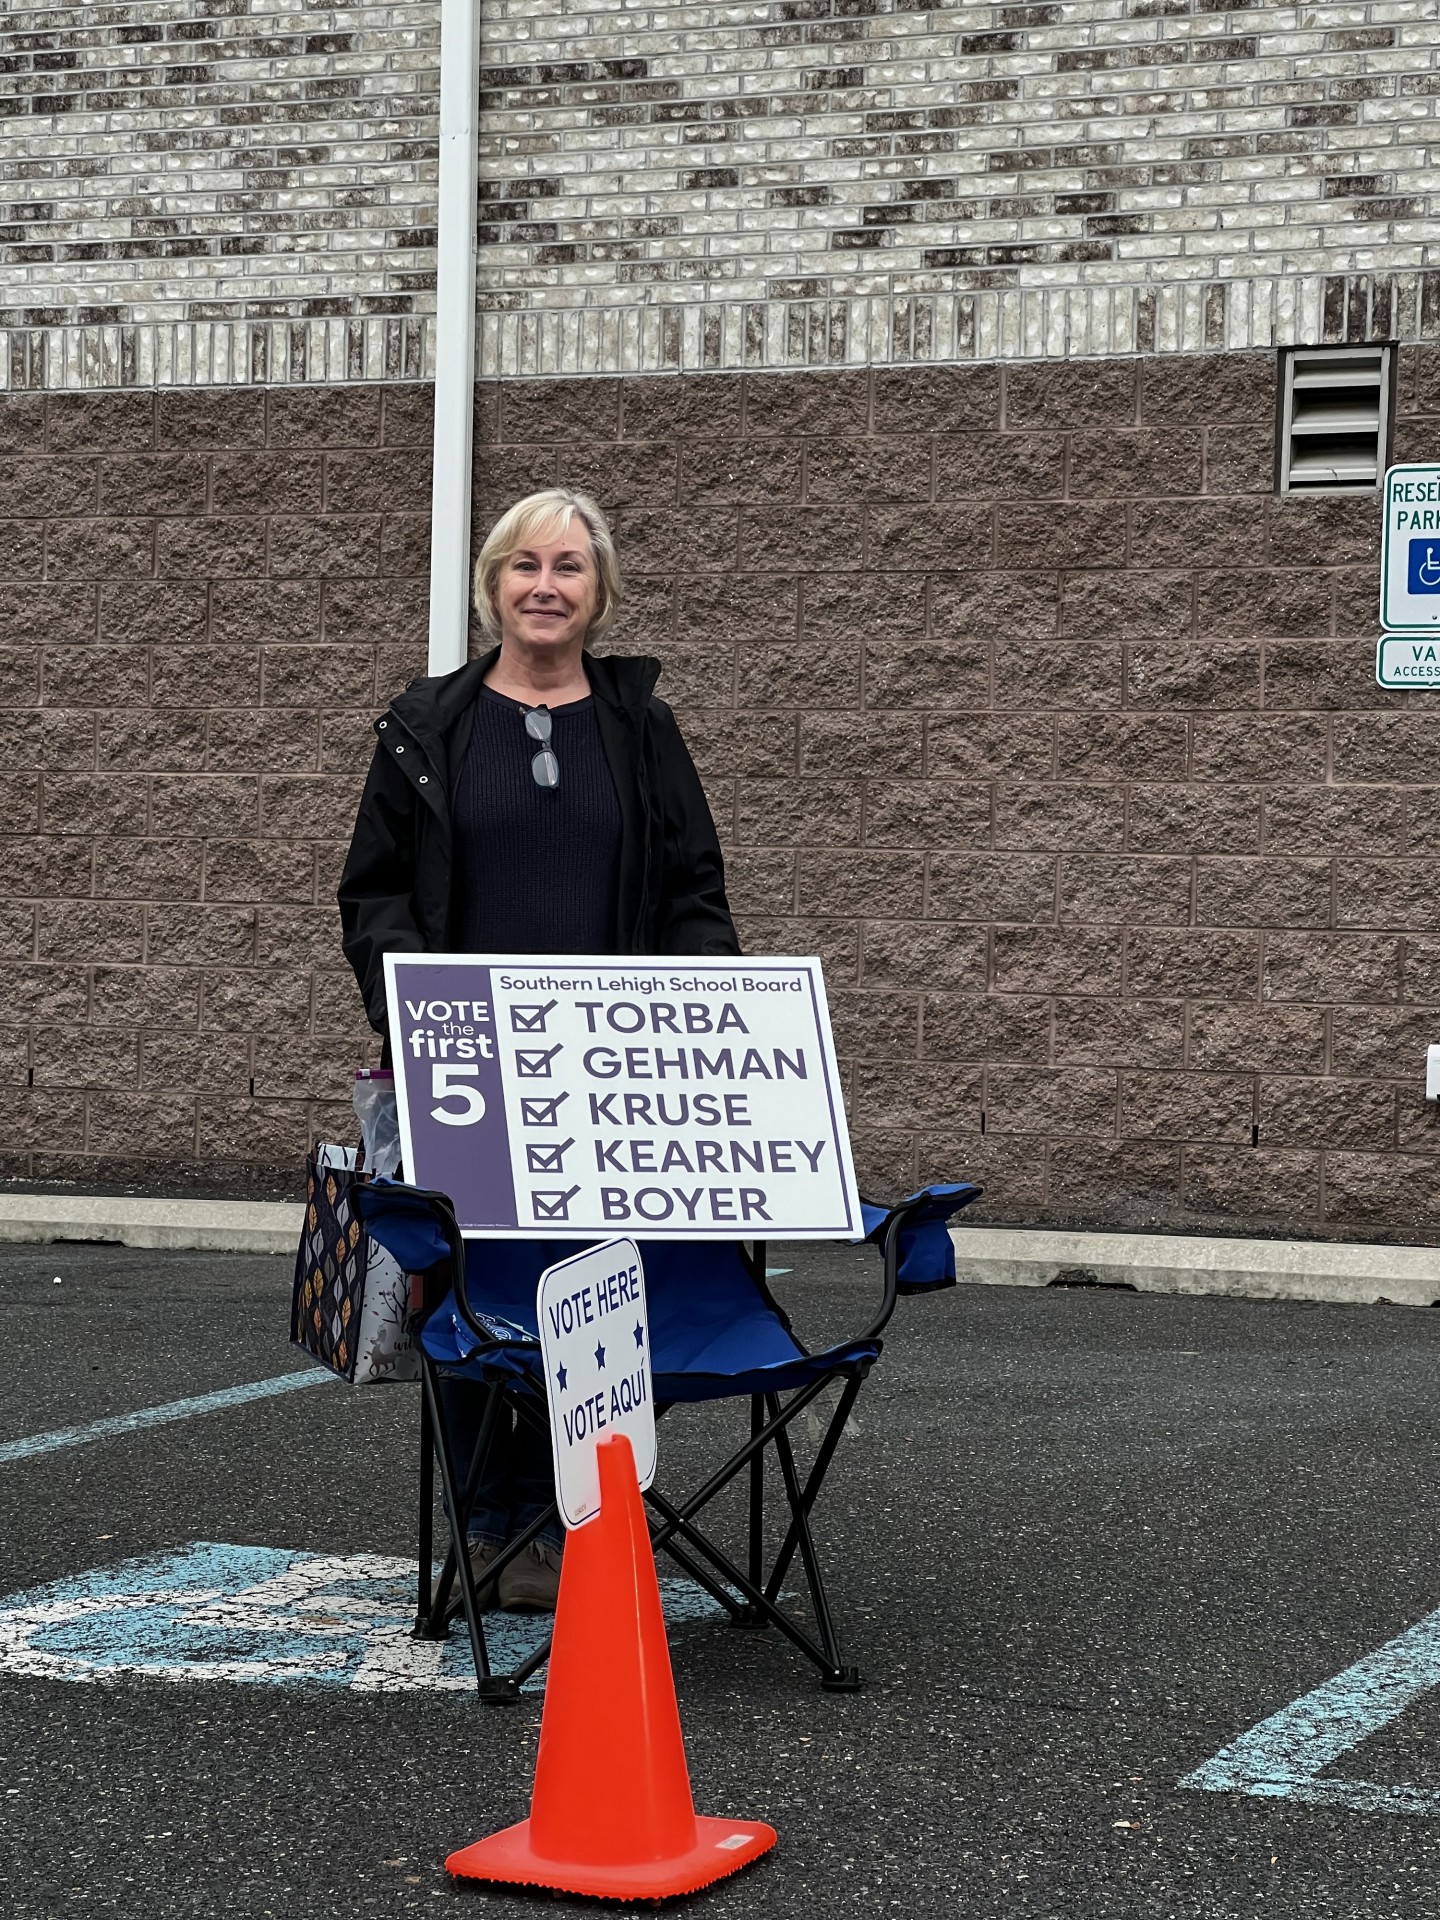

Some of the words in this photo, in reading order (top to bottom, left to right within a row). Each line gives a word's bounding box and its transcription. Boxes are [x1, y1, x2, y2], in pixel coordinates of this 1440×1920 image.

[1393, 482, 1440, 502] RESE
[500, 976, 593, 990] Southern
[597, 976, 665, 995] Lehigh
[669, 977, 737, 992] School
[742, 977, 802, 992] Board
[405, 1000, 490, 1022] VOTE
[575, 1002, 750, 1034] TORBA
[408, 1028, 494, 1059] first
[442, 1022, 474, 1036] the
[583, 1047, 808, 1080] GEHMAN
[429, 1063, 486, 1126] 5
[588, 1093, 752, 1126] KRUSE
[594, 1139, 826, 1173] KEARNEY
[600, 1187, 773, 1221] BOYER
[549, 1287, 594, 1339] VOTE
[596, 1264, 640, 1317] HERE
[563, 1391, 607, 1447] VOTE
[610, 1356, 647, 1422] AQUÍ
